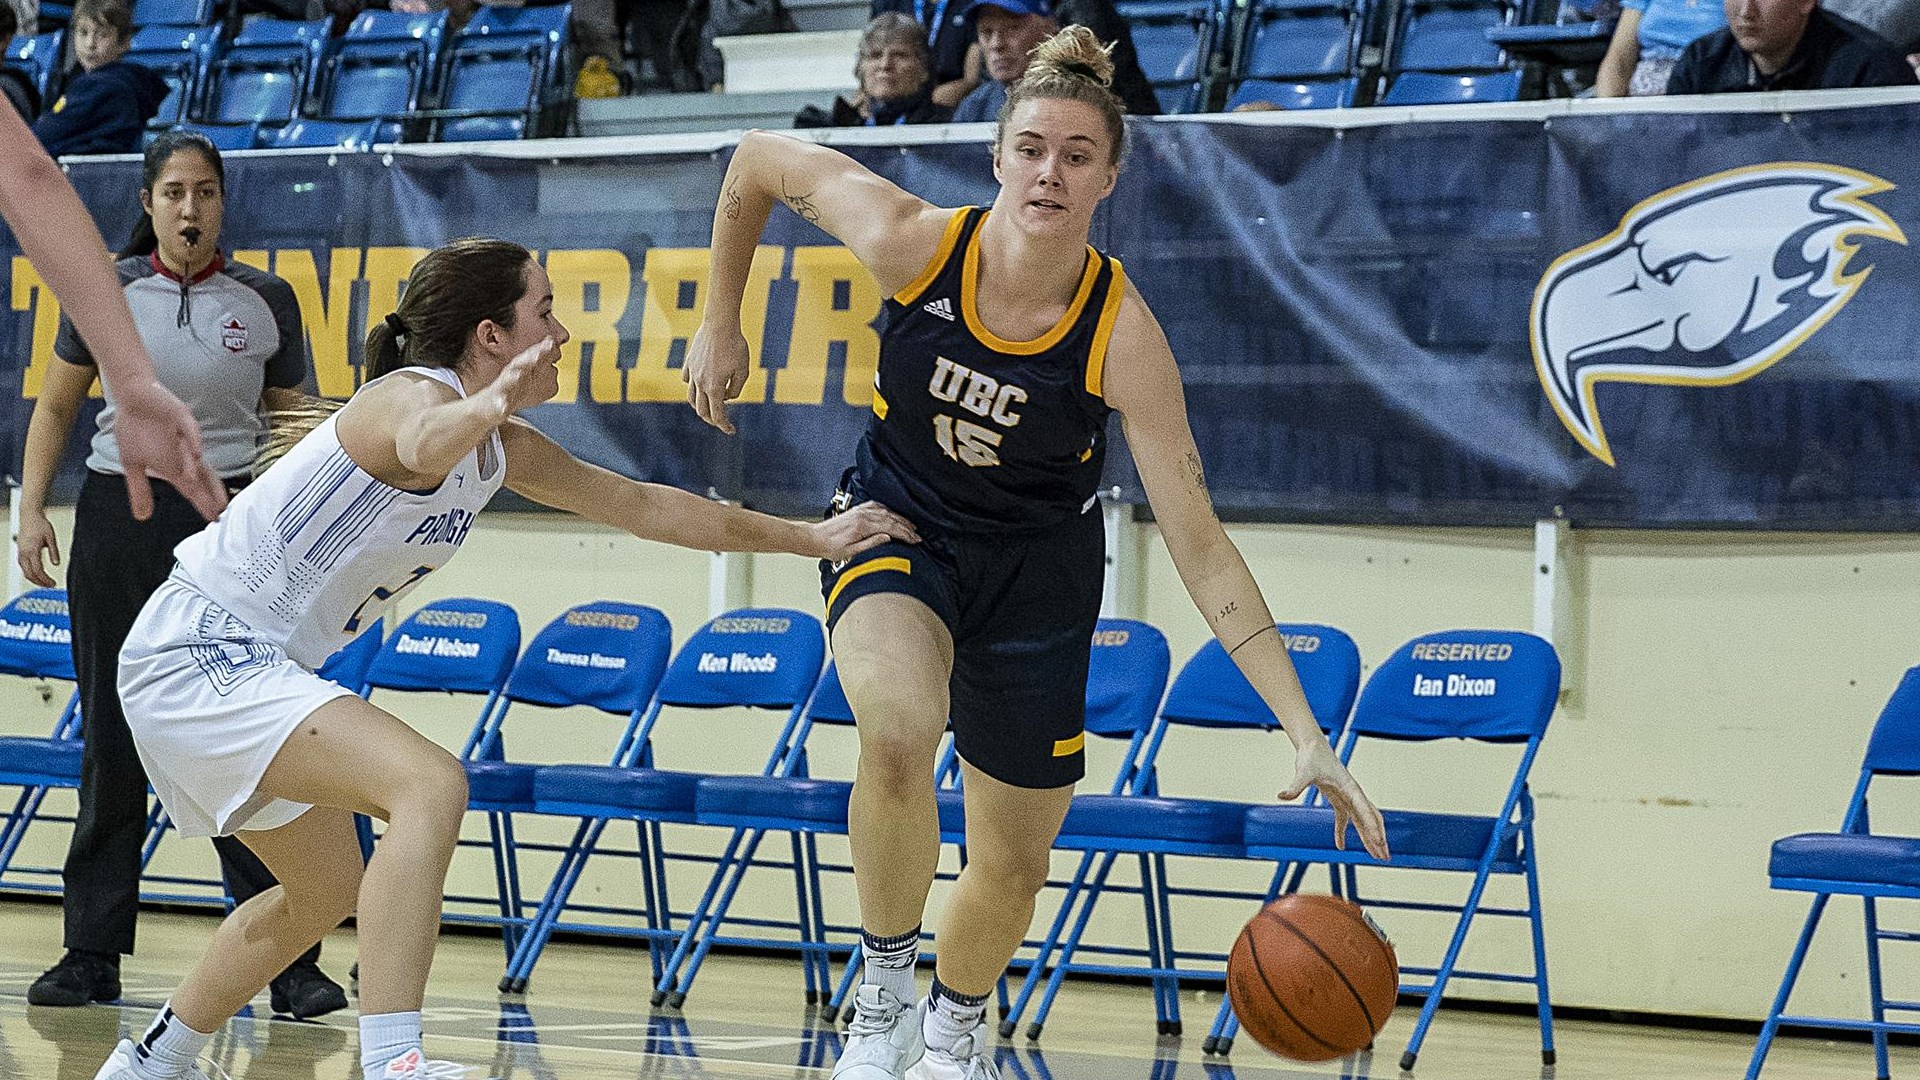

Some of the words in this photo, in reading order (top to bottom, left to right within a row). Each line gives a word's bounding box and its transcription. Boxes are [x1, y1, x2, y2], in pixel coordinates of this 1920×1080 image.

[928, 355, 1029, 428] UBC
[932, 413, 1004, 468] 15
[414, 609, 488, 629] RESERVED
[565, 611, 640, 631] RESERVED
[710, 617, 791, 634] RESERVED
[396, 633, 437, 655] David
[1411, 643, 1513, 661] RESERVED
[697, 652, 729, 673] Ken
[730, 652, 777, 673] Woods
[1413, 673, 1443, 696] Ian
[1446, 674, 1496, 697] Dixon
